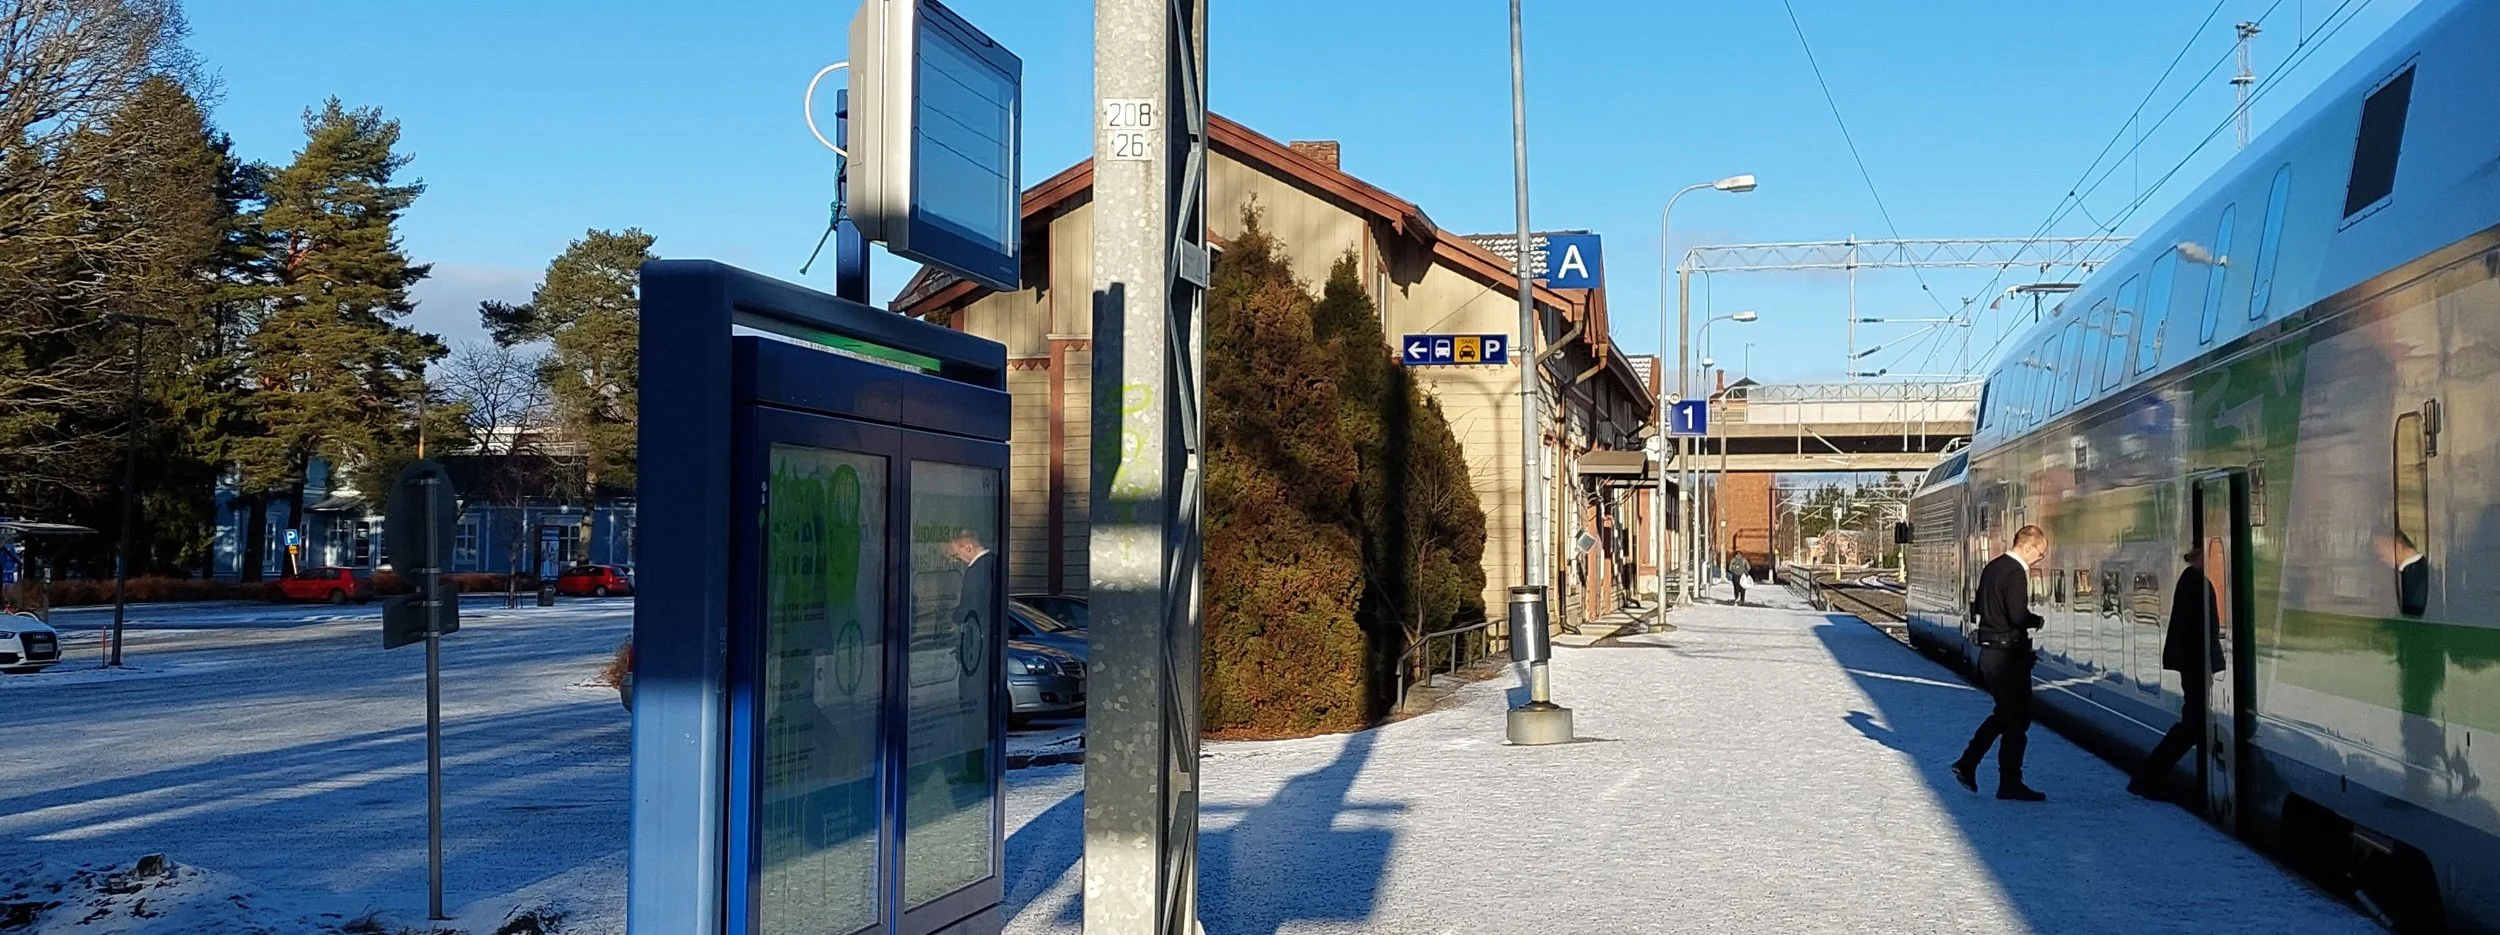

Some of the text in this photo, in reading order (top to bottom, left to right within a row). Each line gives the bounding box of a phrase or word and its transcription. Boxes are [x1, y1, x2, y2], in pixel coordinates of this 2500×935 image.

[1109, 103, 1151, 127] 208
[1117, 133, 1143, 157] 26
[1558, 244, 1589, 280] A
[1485, 339, 1500, 359] P
[1683, 405, 1693, 430] 1
[286, 531, 295, 544] P
